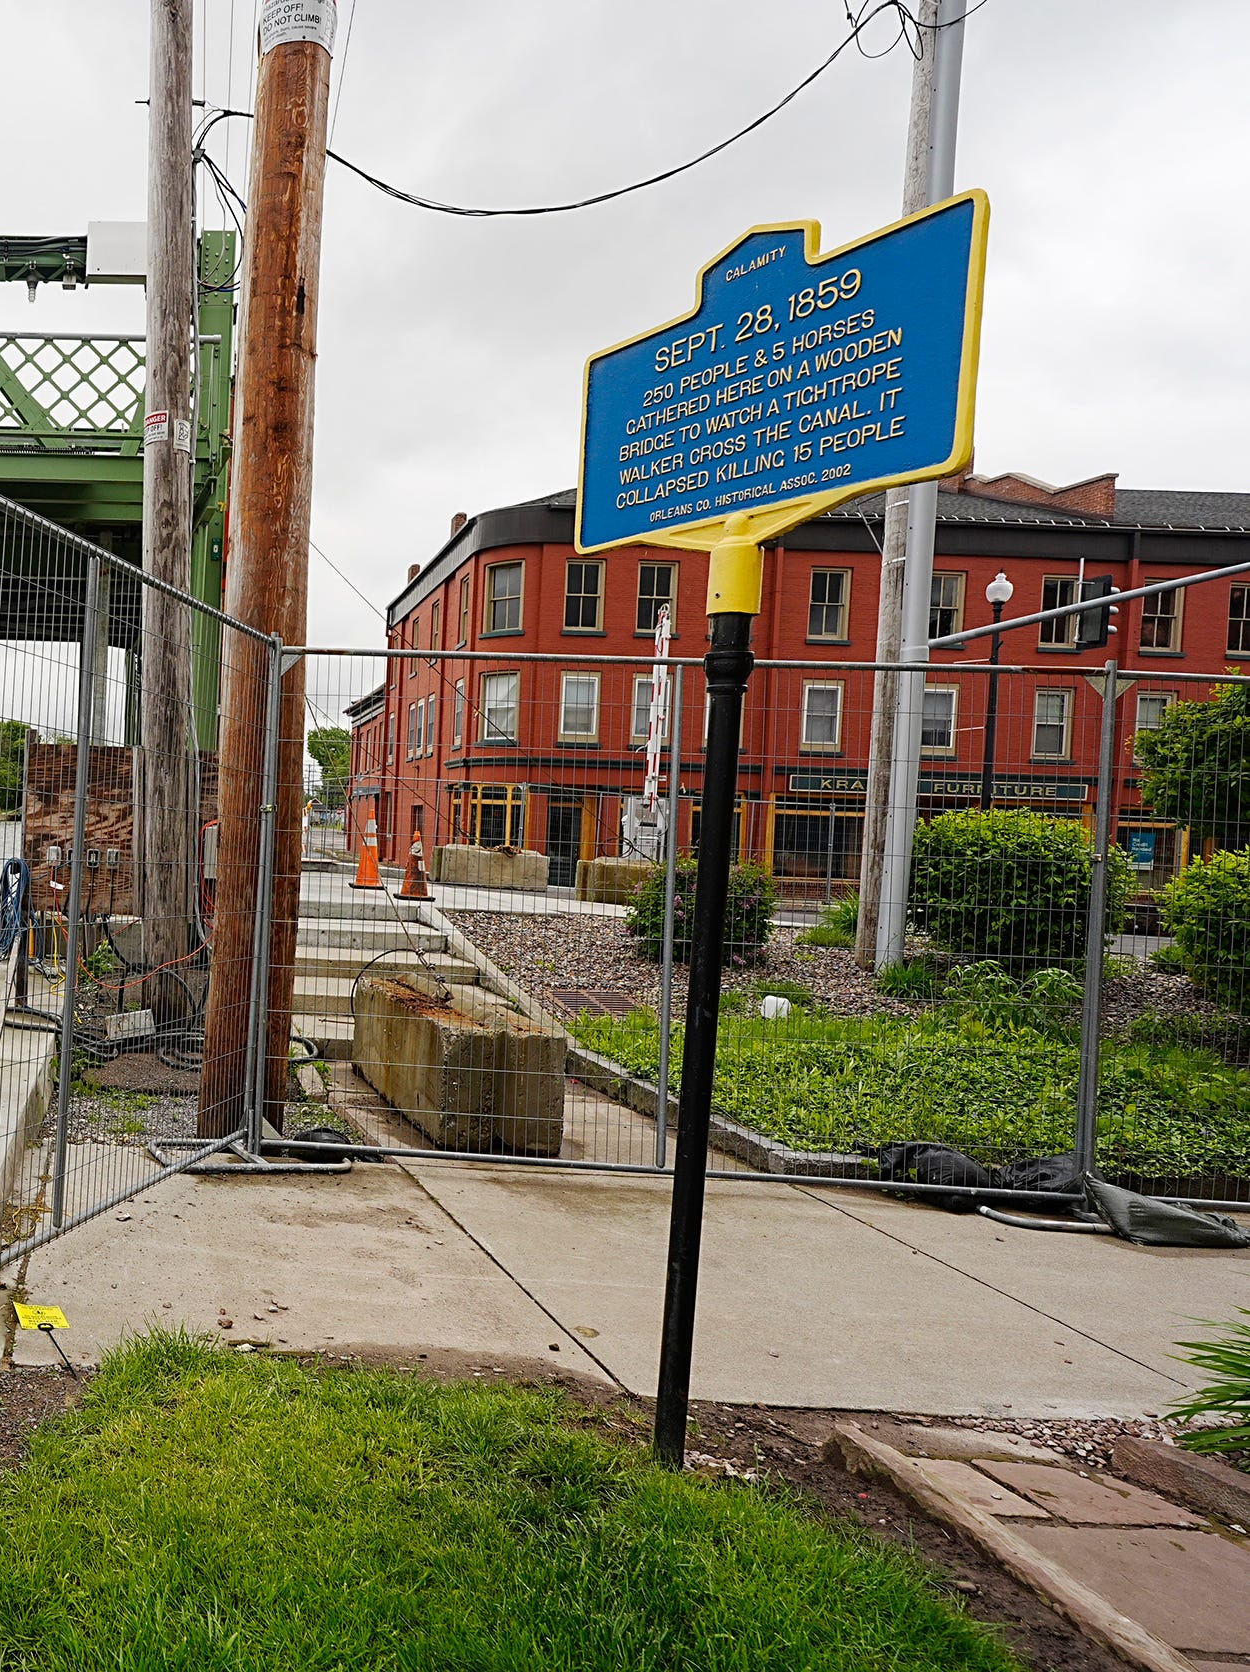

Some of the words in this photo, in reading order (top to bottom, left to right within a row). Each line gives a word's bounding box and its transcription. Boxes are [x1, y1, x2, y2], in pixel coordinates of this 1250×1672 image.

[263, 7, 282, 25] KEEP
[284, 3, 304, 14] OFF!
[263, 23, 273, 35] DO
[274, 15, 292, 27] NOT
[294, 14, 322, 24] CLIMB!
[725, 245, 786, 282] CALAMITY
[643, 382, 674, 408] 250
[680, 355, 749, 394] PEOPLE
[754, 349, 768, 368] &
[772, 342, 785, 361] 5
[792, 308, 875, 355] HORSES
[654, 323, 725, 372] SEPT.
[735, 304, 780, 342] 28,
[788, 268, 862, 321] 1859
[619, 430, 676, 462] BRIDGE
[679, 423, 701, 443] TO
[706, 403, 763, 435] WATCH
[766, 398, 780, 417] A
[783, 357, 903, 411] TIGHTROPE
[626, 394, 711, 435] GATHERED
[716, 374, 764, 406] HERE
[767, 365, 792, 388] ON
[796, 359, 810, 379] A
[815, 327, 903, 372] WOODEN
[616, 470, 709, 509] COLLAPSED
[716, 450, 785, 483] KILLING
[793, 441, 813, 463] 15
[819, 415, 906, 456] PEOPLE
[619, 453, 684, 485] WALKER
[690, 434, 747, 465] CROSS
[753, 420, 792, 447] THE
[799, 400, 872, 434] CANAL.
[879, 387, 903, 412] IT
[650, 503, 693, 523] ORLEANS
[696, 499, 712, 512] CO.
[715, 483, 776, 508] HISTORICAL
[780, 473, 818, 492] ASSOC.
[821, 463, 851, 482] 2002
